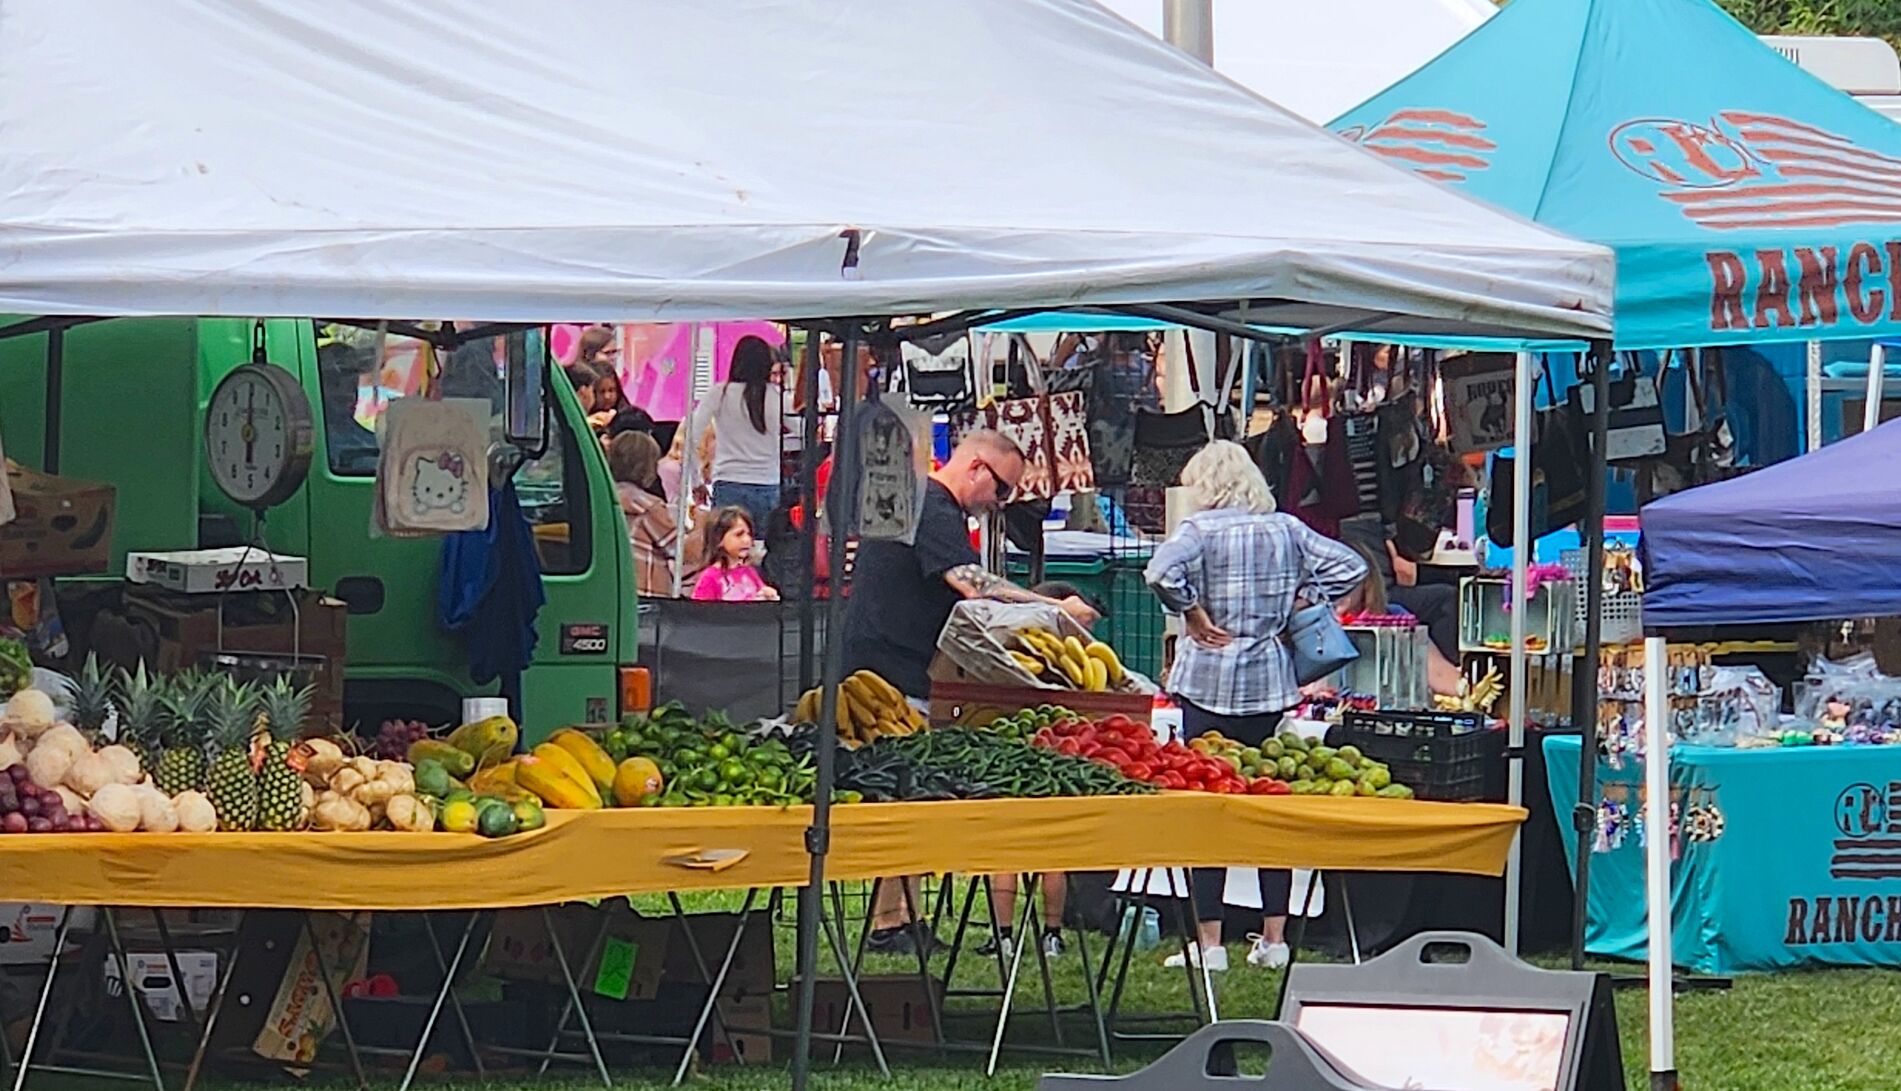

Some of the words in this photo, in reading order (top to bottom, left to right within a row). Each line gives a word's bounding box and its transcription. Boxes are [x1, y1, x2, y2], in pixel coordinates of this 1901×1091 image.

[247, 473, 254, 489] 5
[570, 626, 601, 636] GMC
[573, 639, 607, 651] 4500
